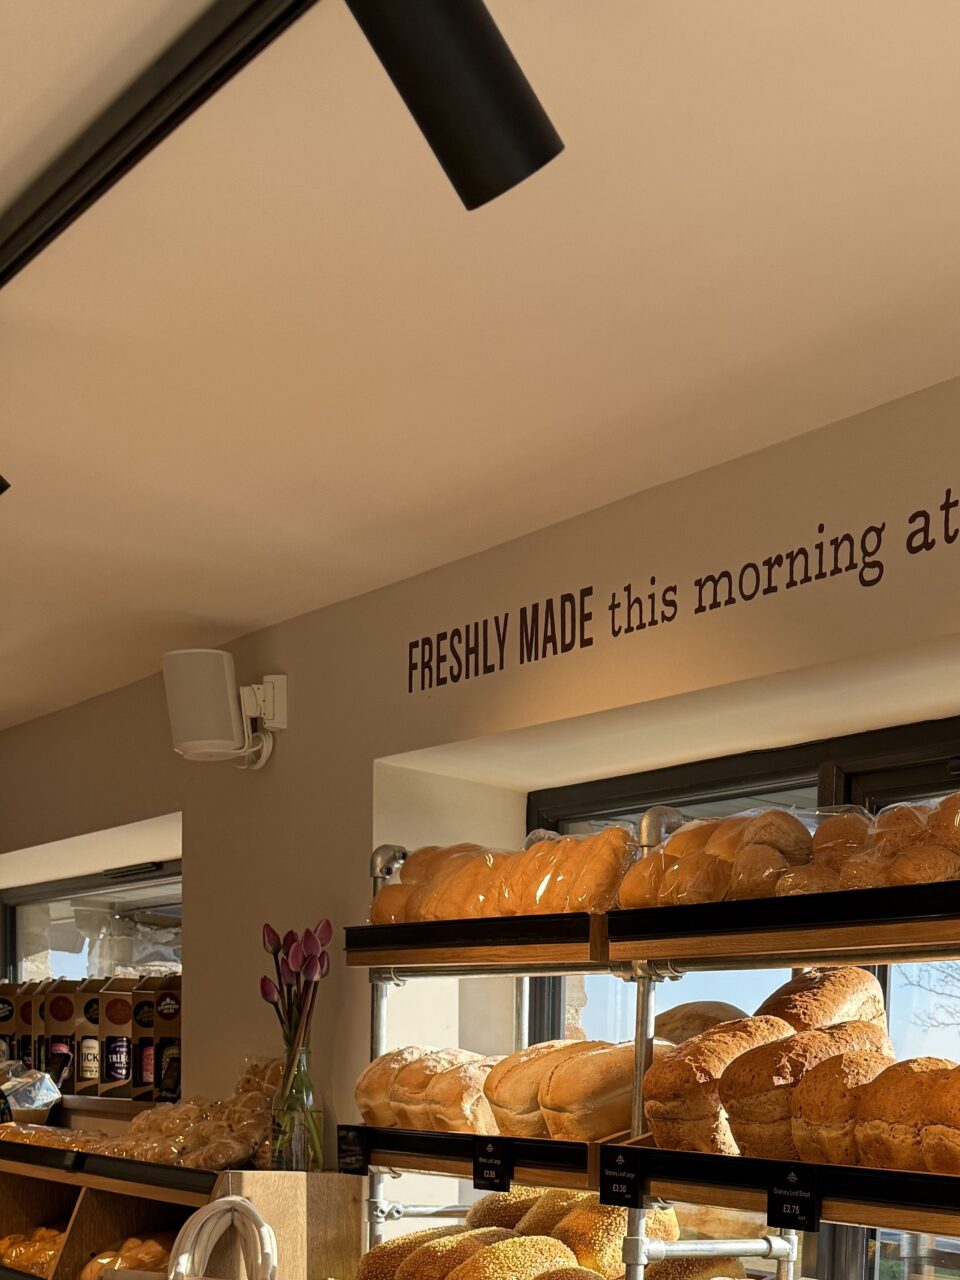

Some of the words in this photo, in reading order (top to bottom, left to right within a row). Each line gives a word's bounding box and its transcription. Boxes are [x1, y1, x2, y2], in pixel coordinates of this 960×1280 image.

[407, 612, 511, 694] FRESHLY
[518, 587, 596, 667] MADE
[608, 576, 679, 638] this
[693, 520, 887, 616] morning
[905, 487, 960, 555] at
